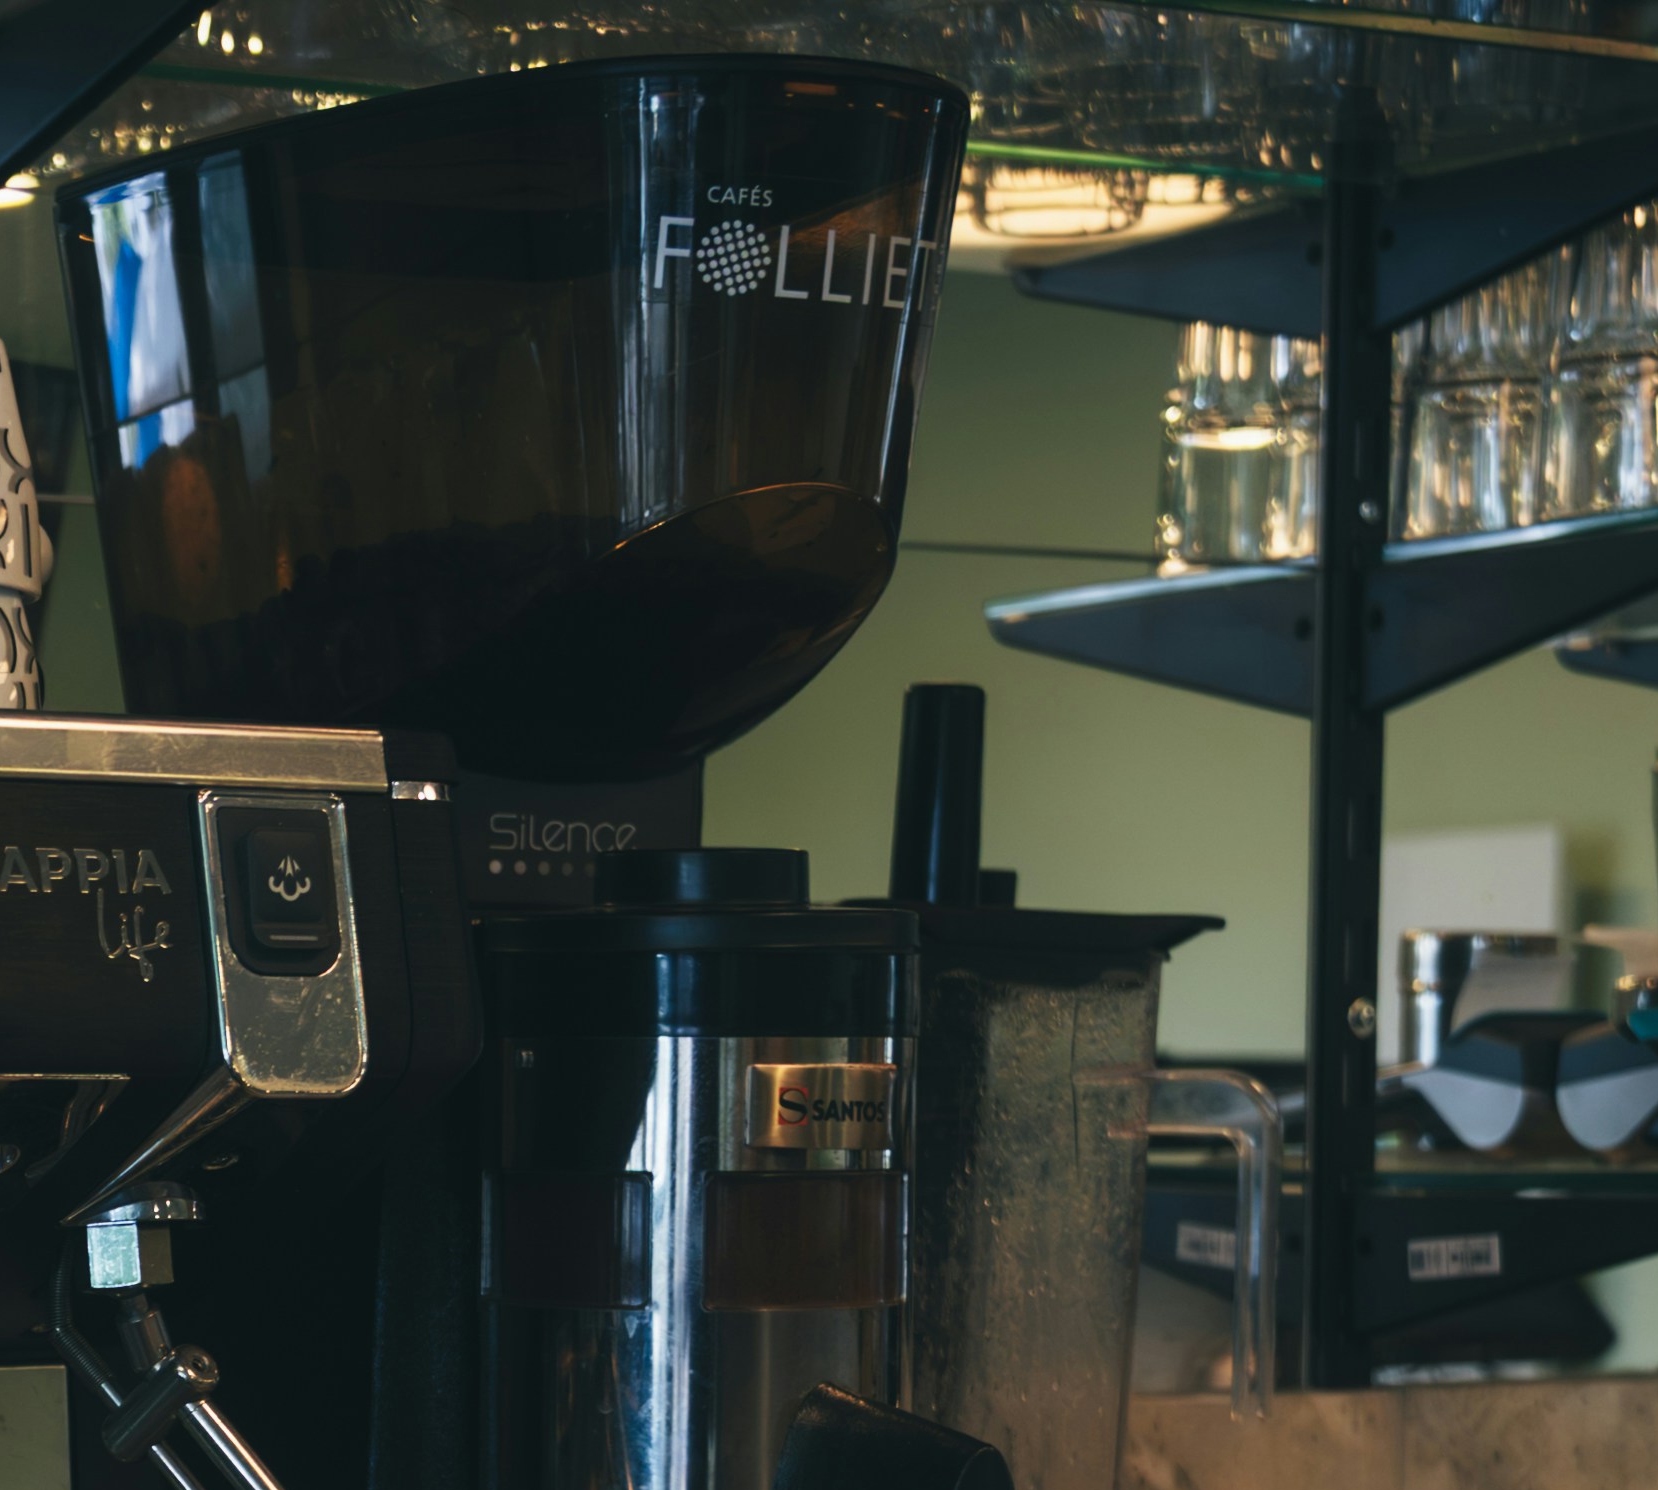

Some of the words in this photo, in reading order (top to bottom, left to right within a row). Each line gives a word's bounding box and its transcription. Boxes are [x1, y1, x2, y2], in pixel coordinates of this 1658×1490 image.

[707, 185, 773, 207] CAFÉS
[653, 215, 937, 312] FOLLIET
[489, 813, 638, 855] Silence
[812, 1099, 885, 1122] SANTOS
